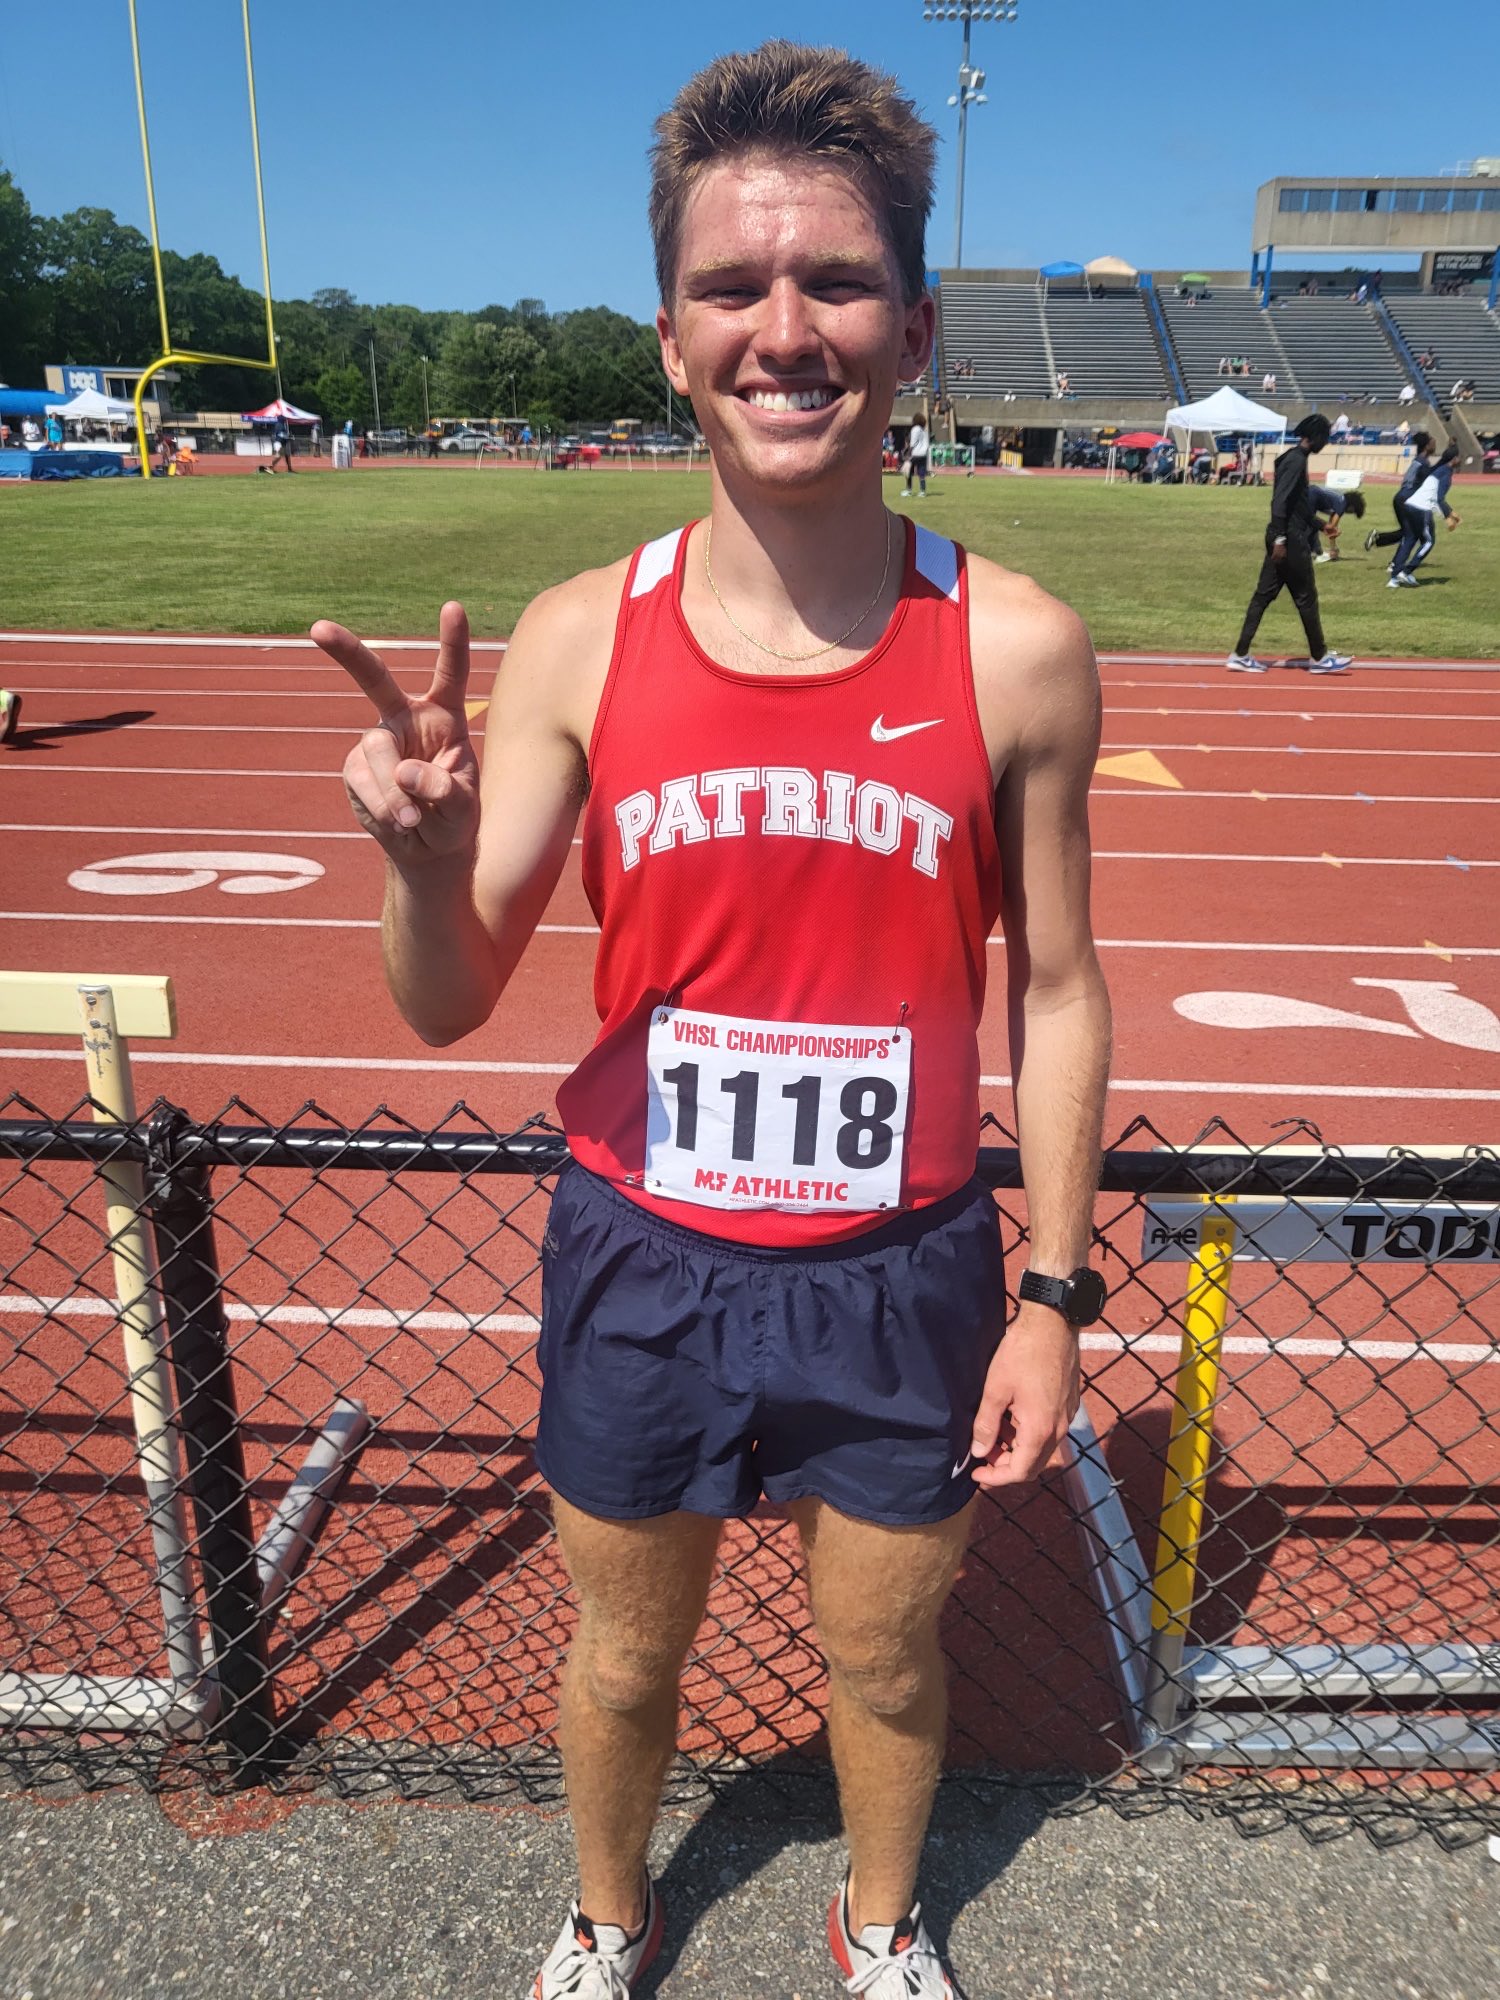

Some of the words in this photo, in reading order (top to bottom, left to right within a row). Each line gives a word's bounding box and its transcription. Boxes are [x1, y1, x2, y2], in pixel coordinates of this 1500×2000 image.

[615, 766, 954, 879] PATRIOT
[674, 1020, 720, 1048] VHSL
[727, 1029, 890, 1059] CHAMPIONSHIPS
[663, 1061, 898, 1170] 1118
[732, 1175, 849, 1202] ATHLETIC
[1342, 1215, 1500, 1259] TOD
